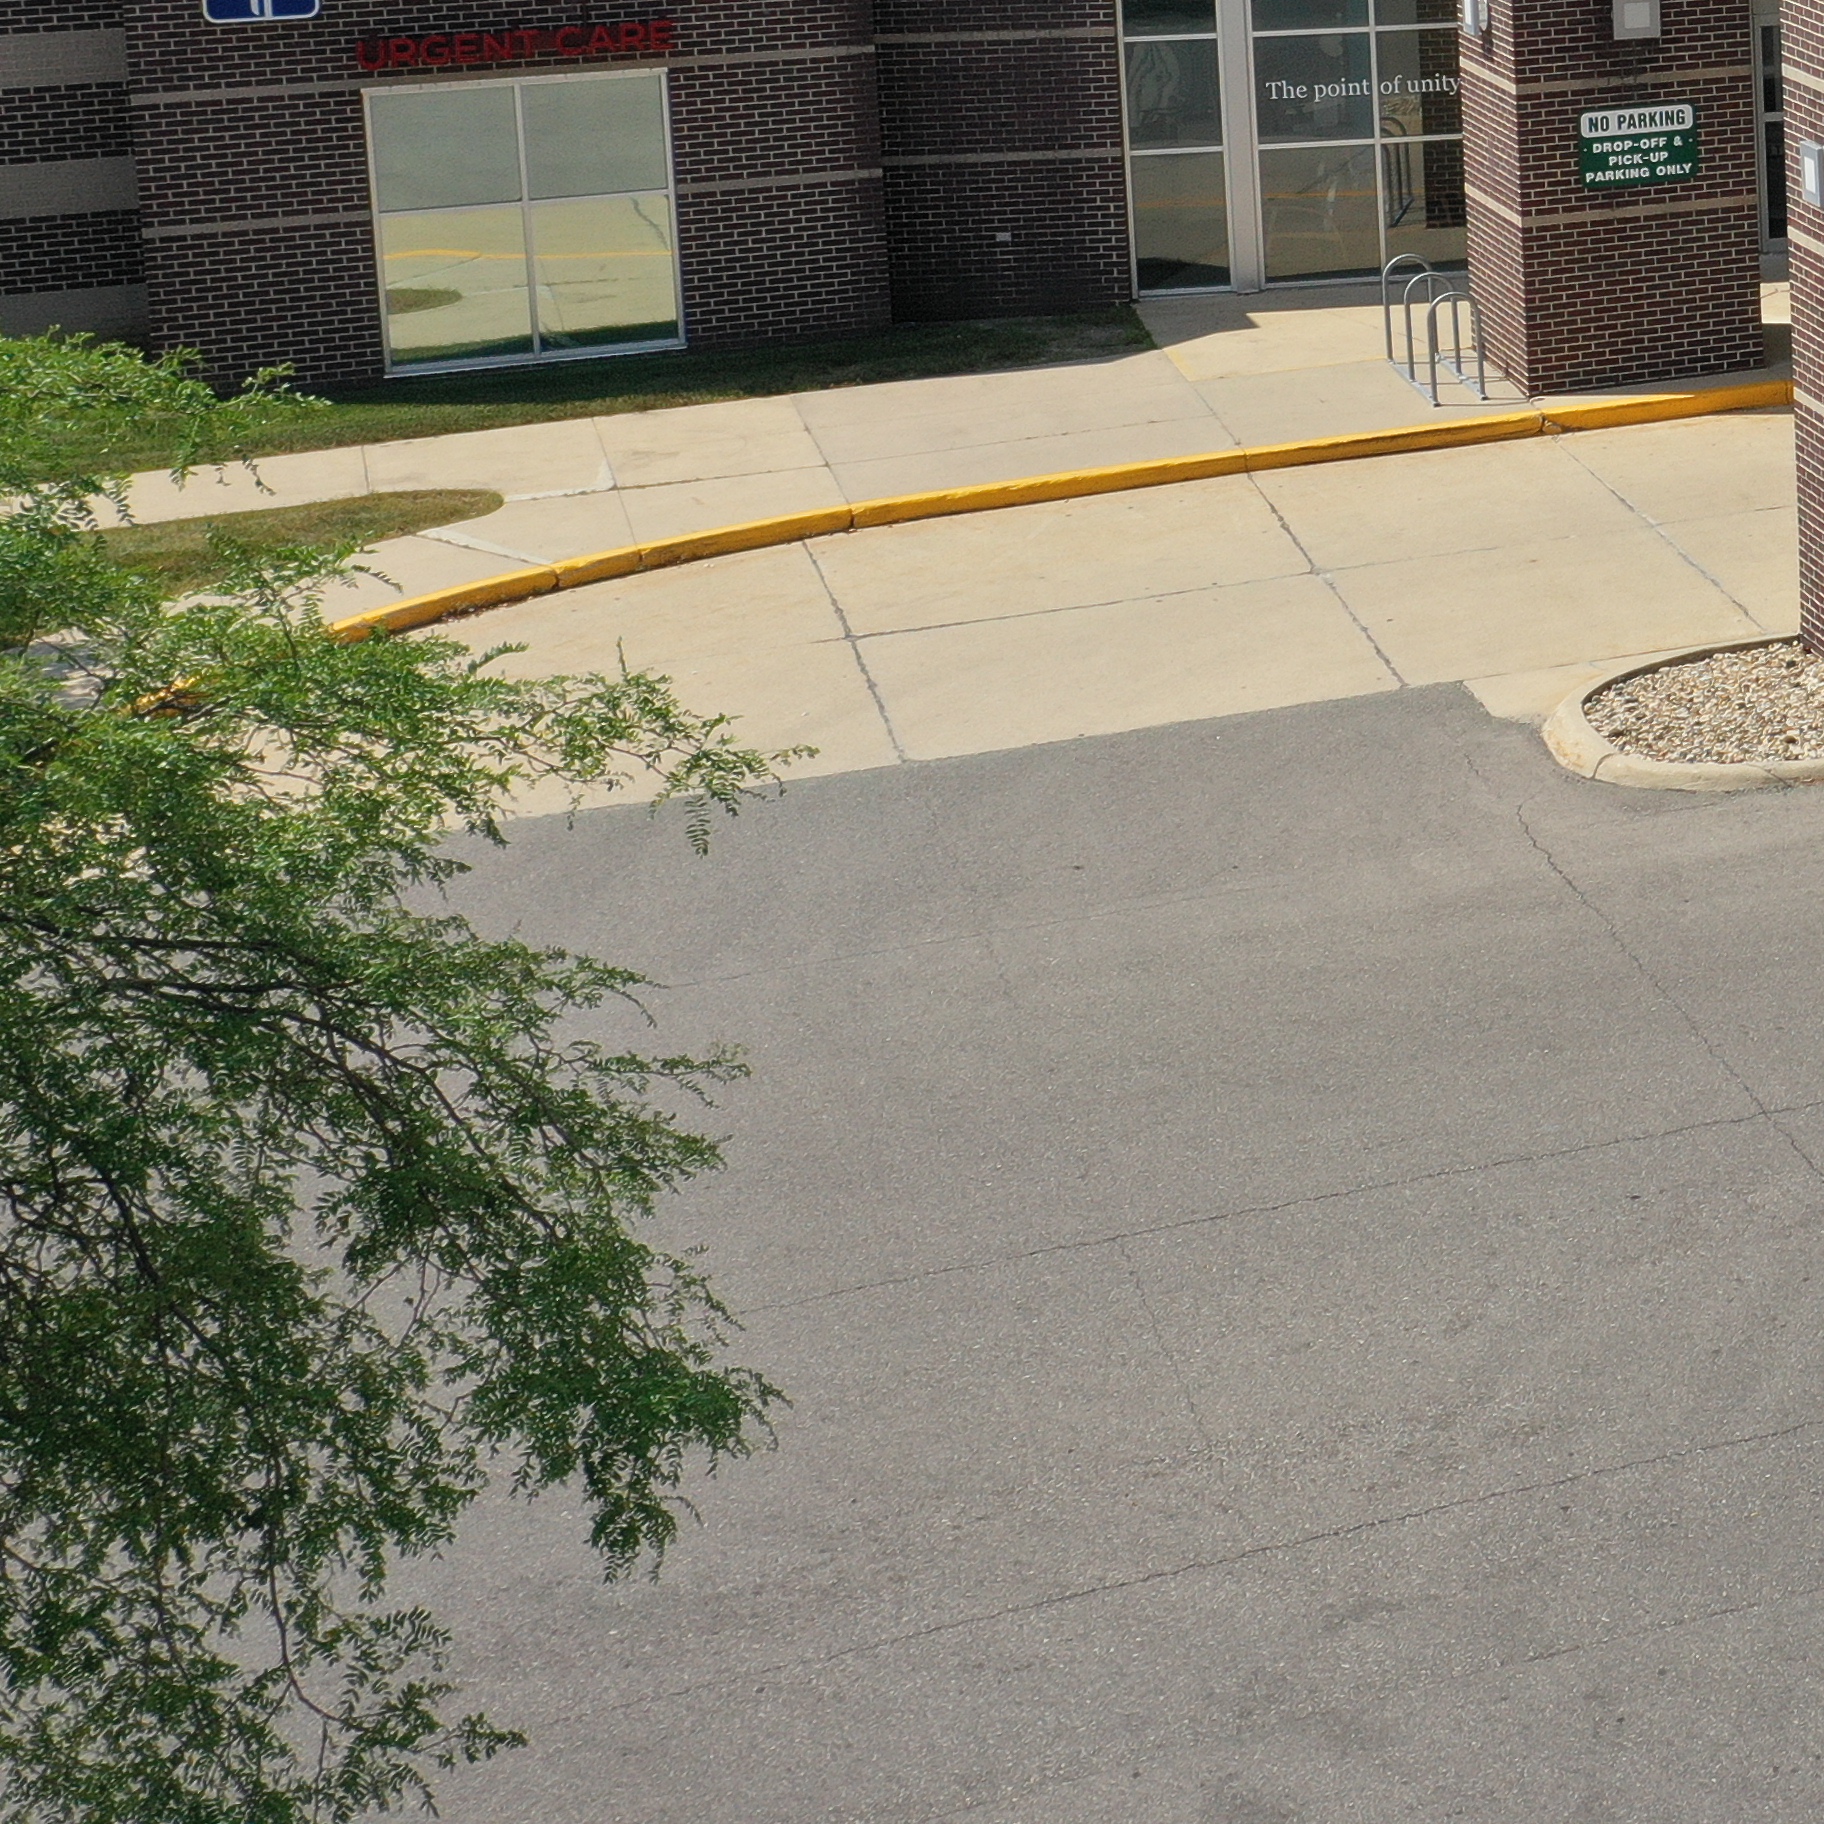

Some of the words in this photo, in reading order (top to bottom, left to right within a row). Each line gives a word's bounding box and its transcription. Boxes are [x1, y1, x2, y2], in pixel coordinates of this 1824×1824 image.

[355, 27, 541, 71] URGENT
[555, 19, 676, 56] CARE
[1265, 79, 1308, 100] The
[1313, 77, 1370, 103] point
[1380, 74, 1403, 95] of
[1406, 72, 1461, 95] unity
[1588, 115, 1610, 133] NO
[1617, 108, 1686, 130] PARKING
[1592, 137, 1668, 154] DROP-OFF
[1673, 135, 1683, 147] &
[1608, 151, 1669, 167] PICK-UP
[1585, 166, 1650, 183] PARKING
[1656, 163, 1692, 176] ONLY
